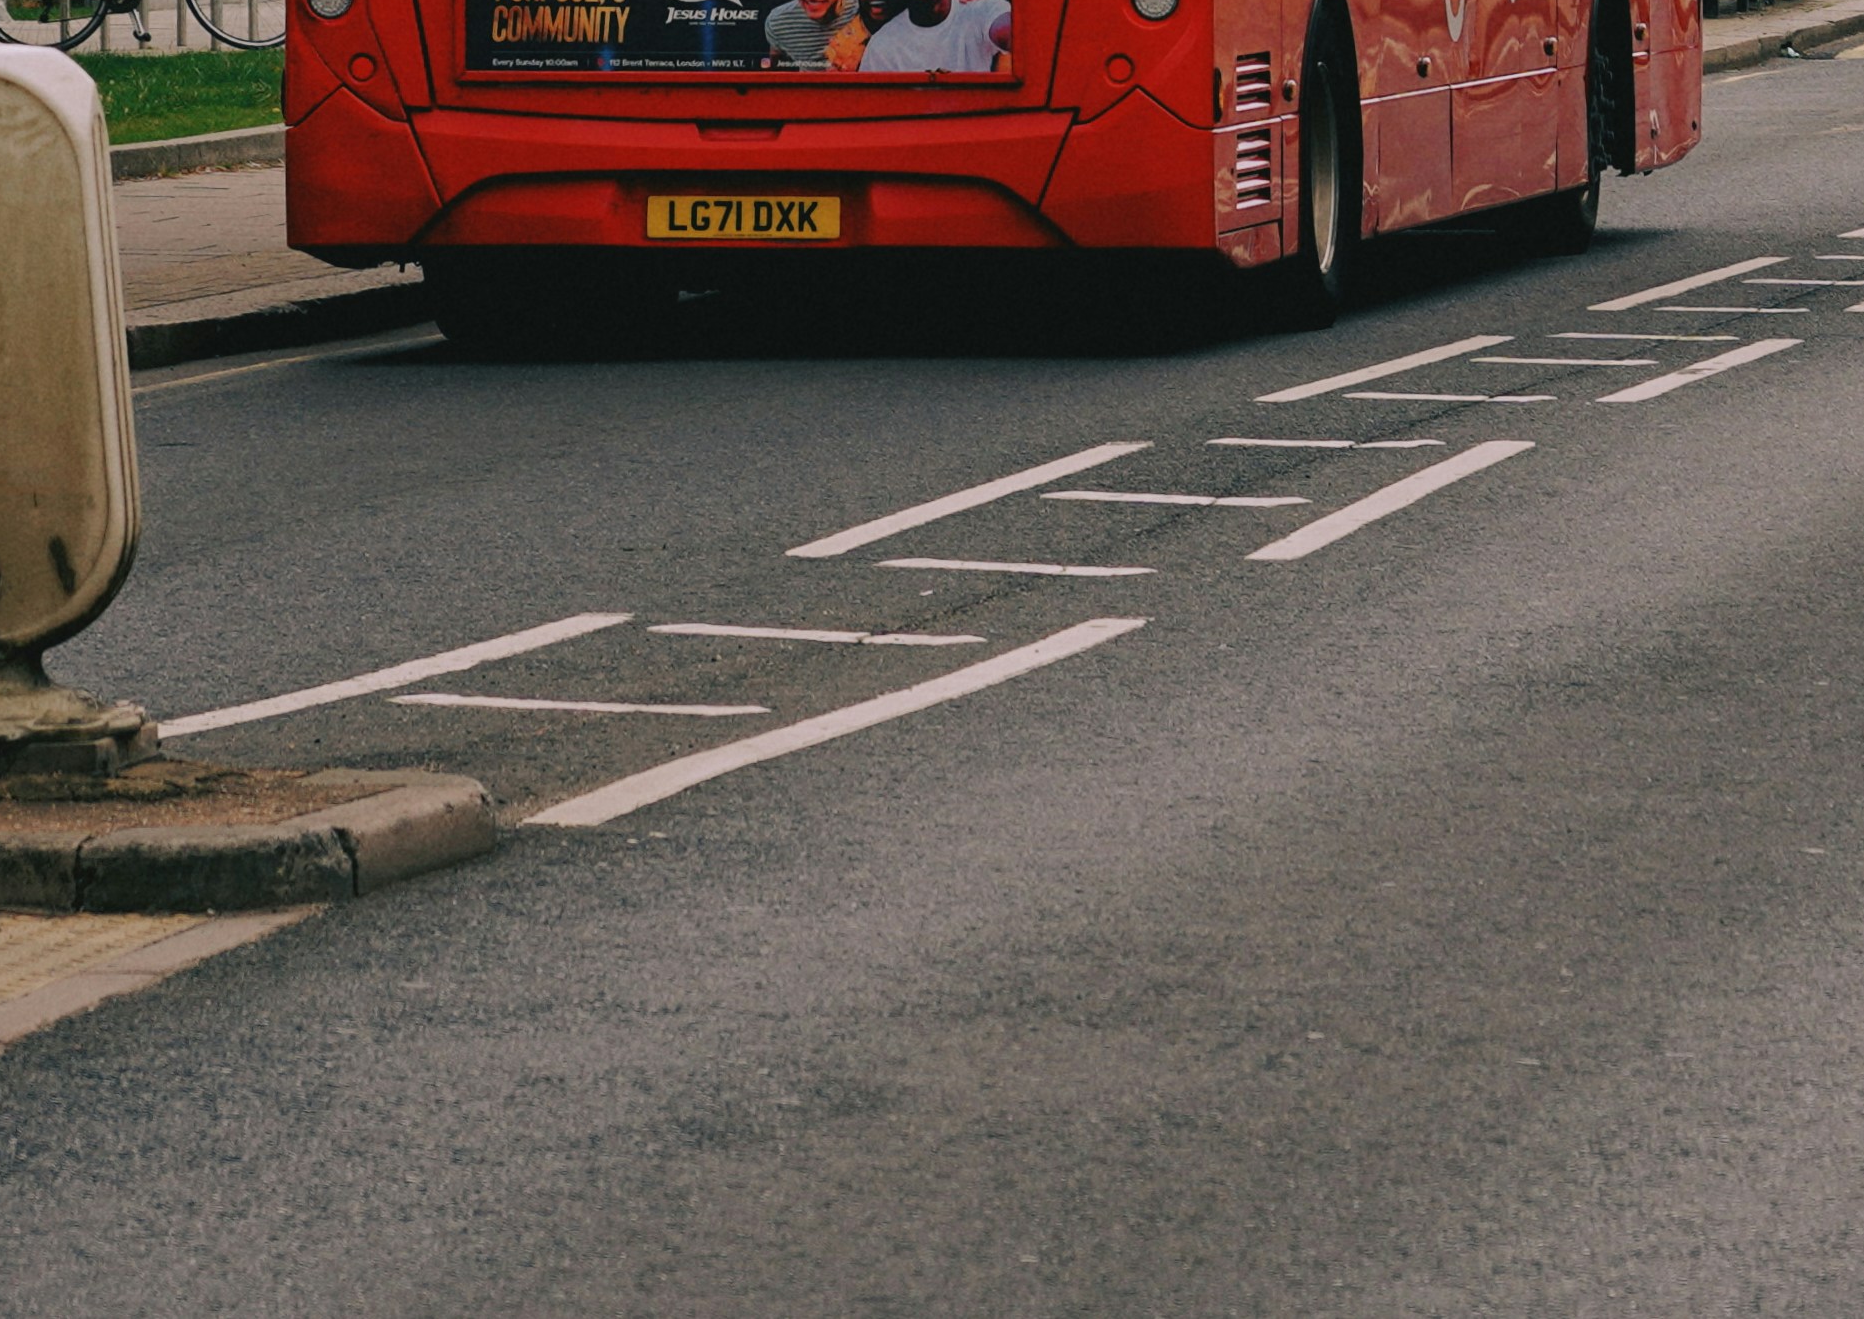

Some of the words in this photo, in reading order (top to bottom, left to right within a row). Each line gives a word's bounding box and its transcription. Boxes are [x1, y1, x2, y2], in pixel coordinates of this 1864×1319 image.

[492, 6, 630, 43] COMMUNITY
[668, 200, 743, 231] LG71
[752, 201, 818, 232] DXK
